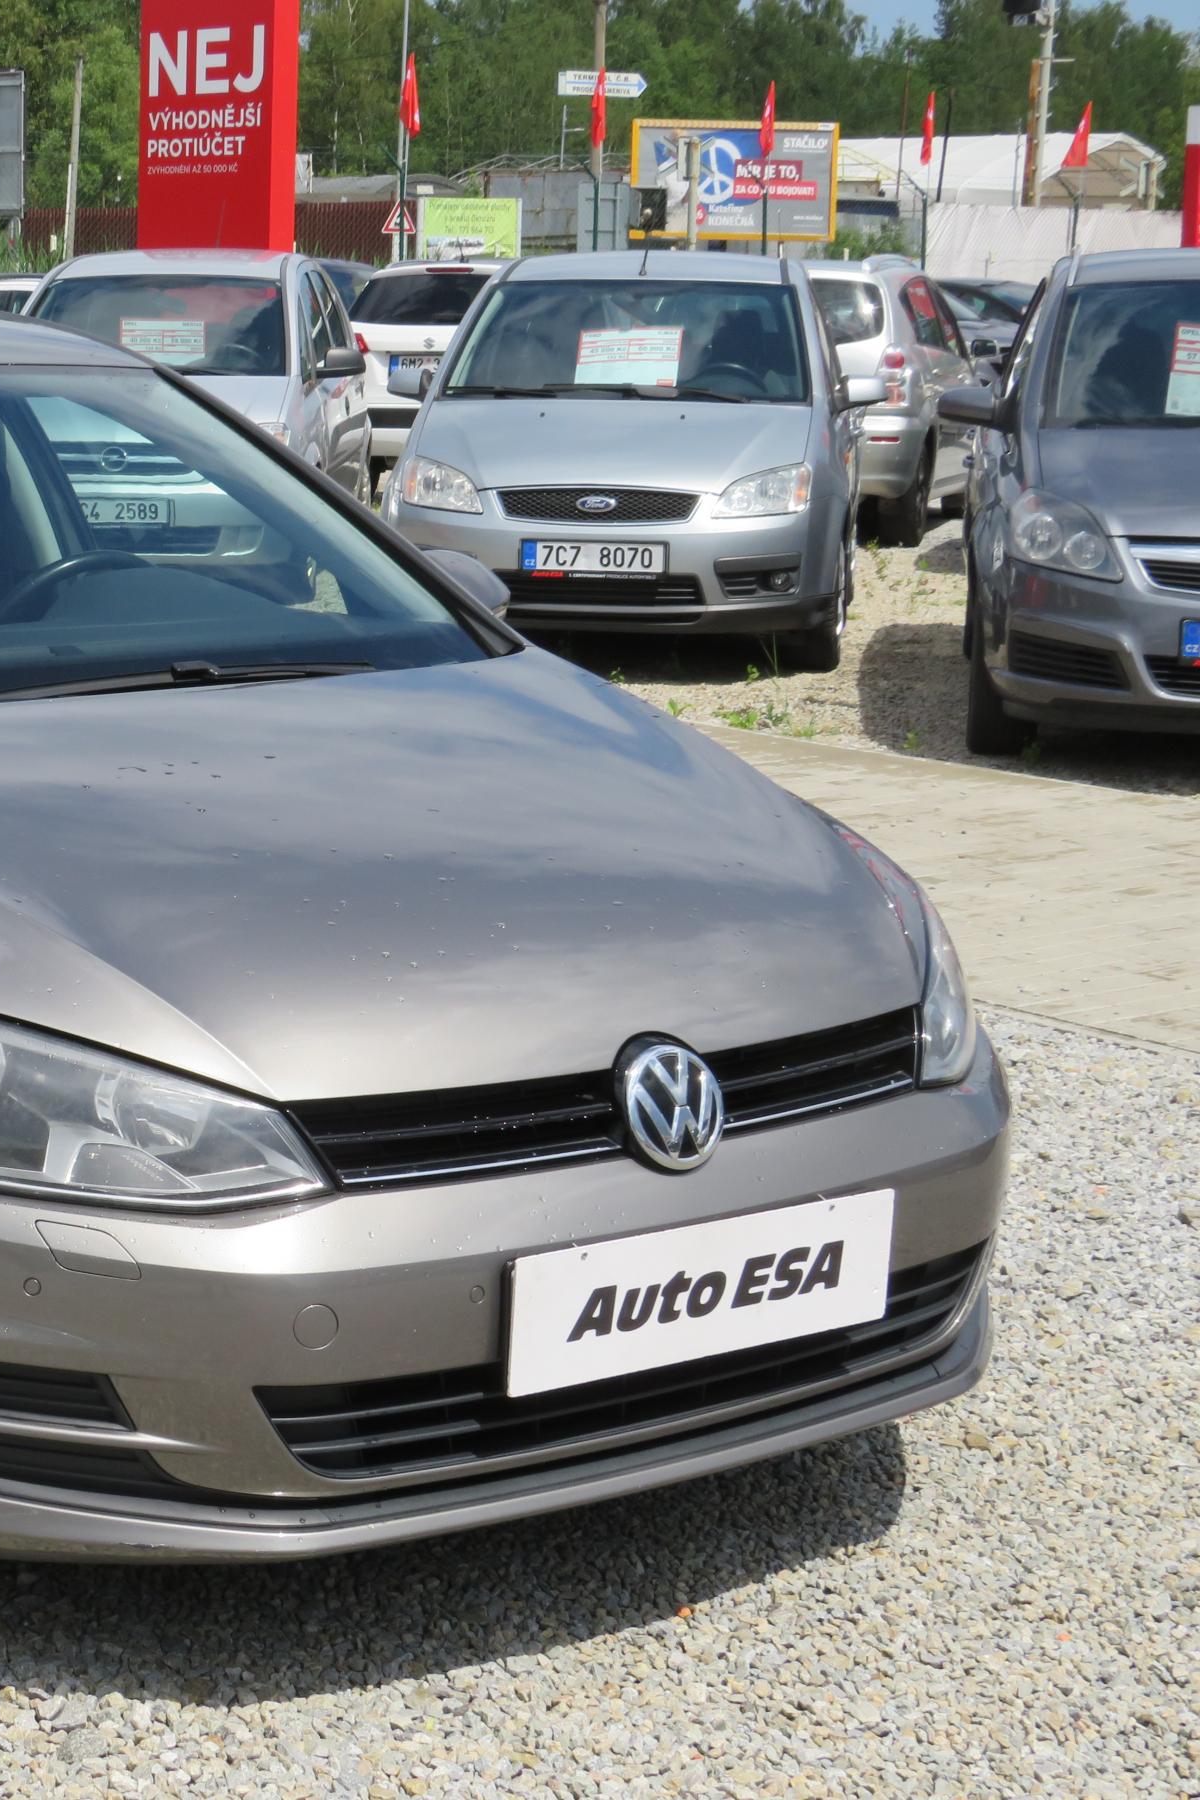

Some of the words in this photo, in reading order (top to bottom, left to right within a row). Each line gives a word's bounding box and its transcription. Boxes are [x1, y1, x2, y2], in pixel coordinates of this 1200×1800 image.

[149, 24, 265, 97] NEJ
[149, 102, 263, 131] VÝHODNĚJŠÍ
[147, 132, 246, 158] PROTIÚČET
[191, 163, 202, 174] AŽ
[202, 165, 212, 174] 50
[212, 164, 227, 173] 000
[778, 164, 800, 182] TO,
[115, 502, 159, 520] 2589
[542, 545, 582, 567] 7C7
[599, 546, 653, 569] 8070
[1185, 643, 1199, 653] CZ
[566, 1270, 727, 1343] Auto
[731, 1240, 845, 1309] ESA
